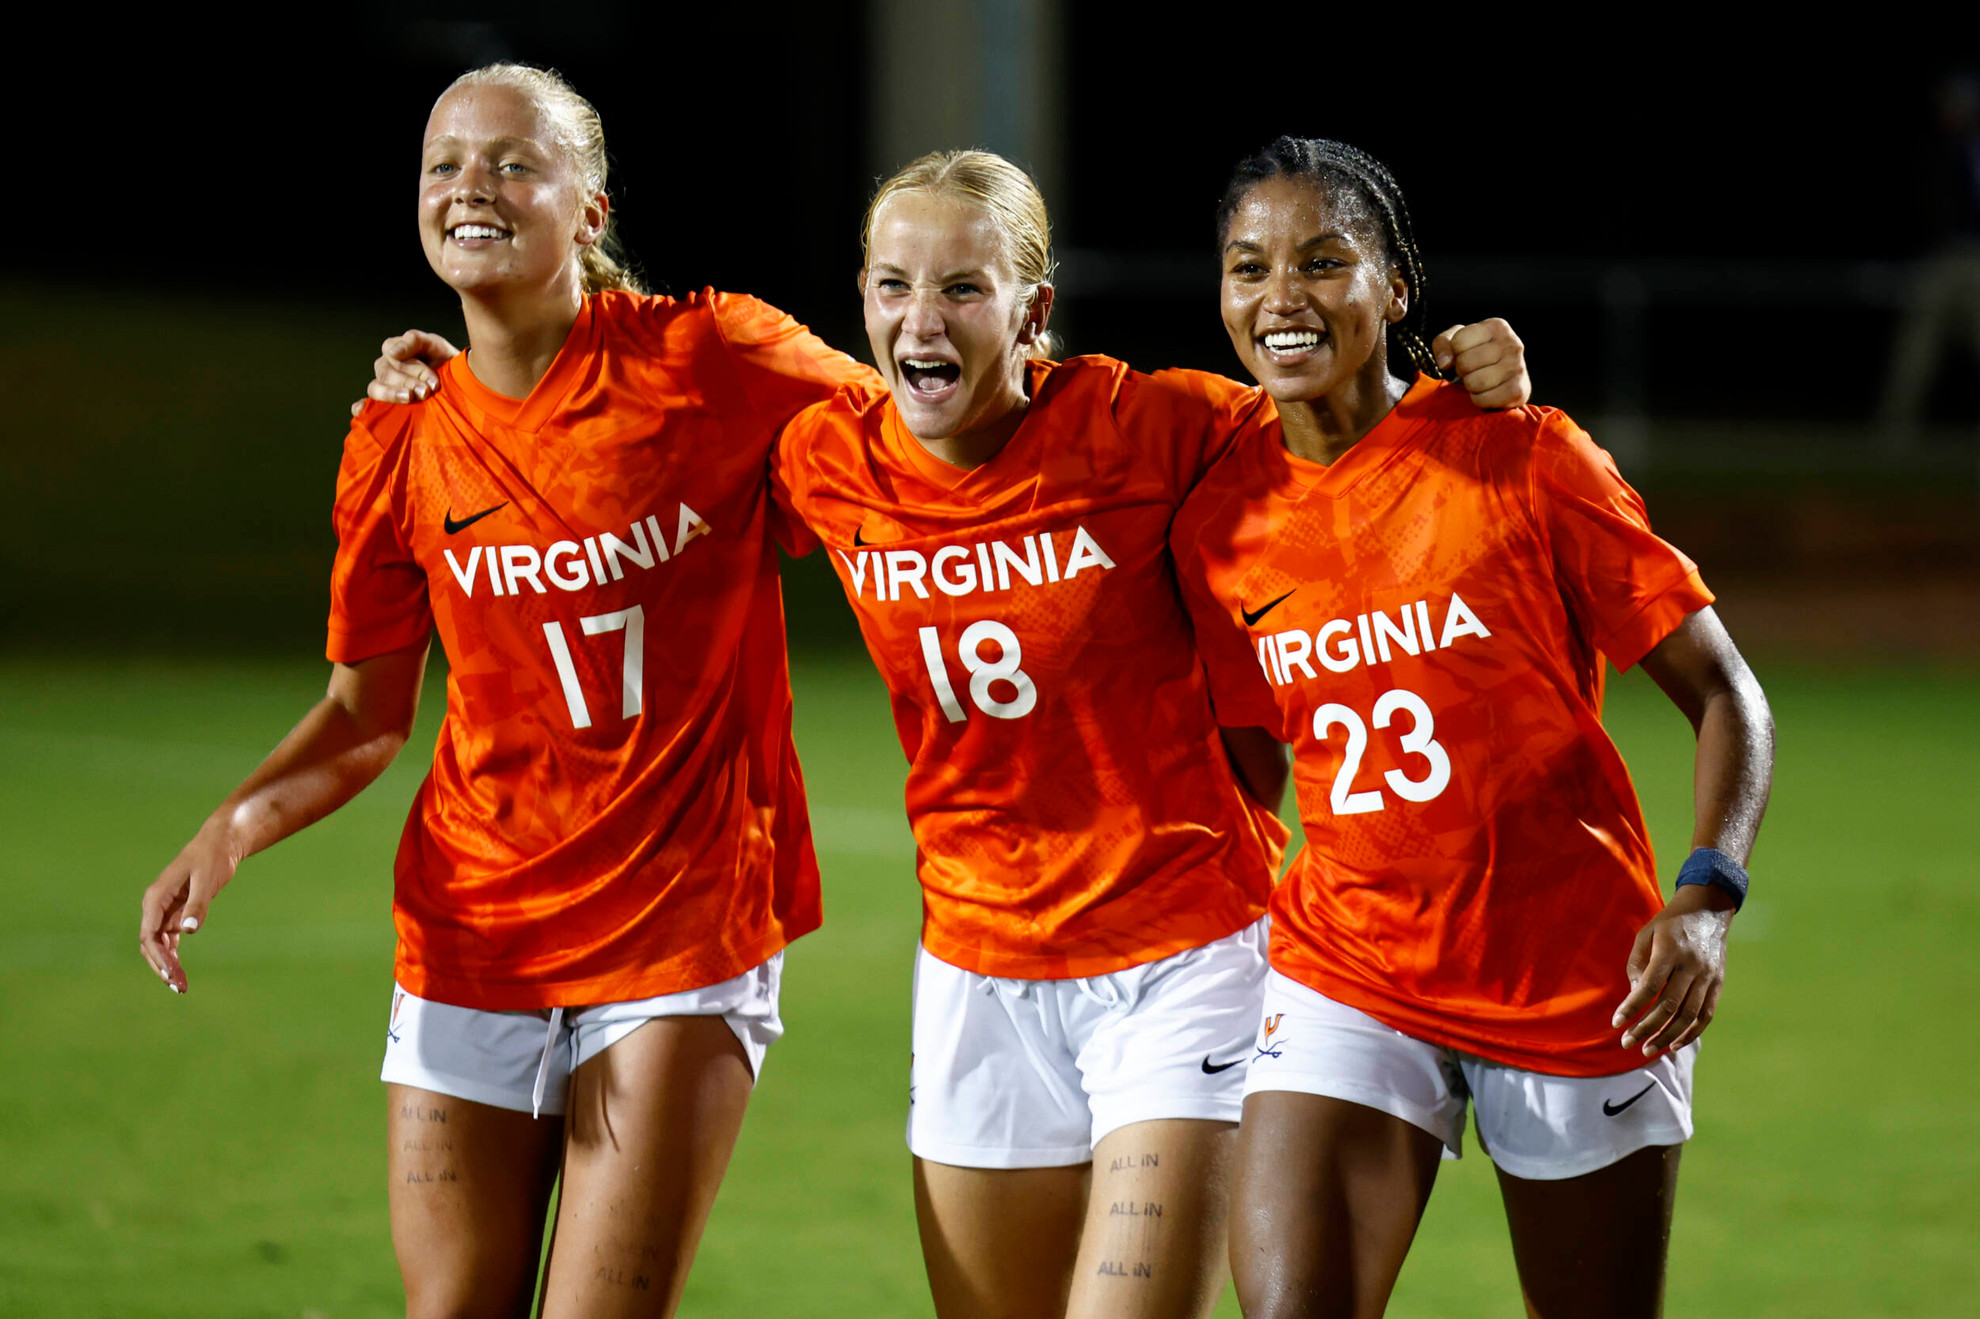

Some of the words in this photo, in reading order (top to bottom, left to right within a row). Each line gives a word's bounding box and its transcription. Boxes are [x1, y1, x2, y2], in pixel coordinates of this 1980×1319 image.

[444, 501, 712, 599] VIRGINIA
[836, 525, 1117, 601] VIRGINIA
[542, 604, 645, 729] 17
[918, 619, 1038, 723] 18
[1312, 688, 1452, 816] 23
[1110, 1156, 1136, 1173] ALL
[1109, 1201, 1139, 1216] ALL
[1097, 1261, 1128, 1277] ALL
